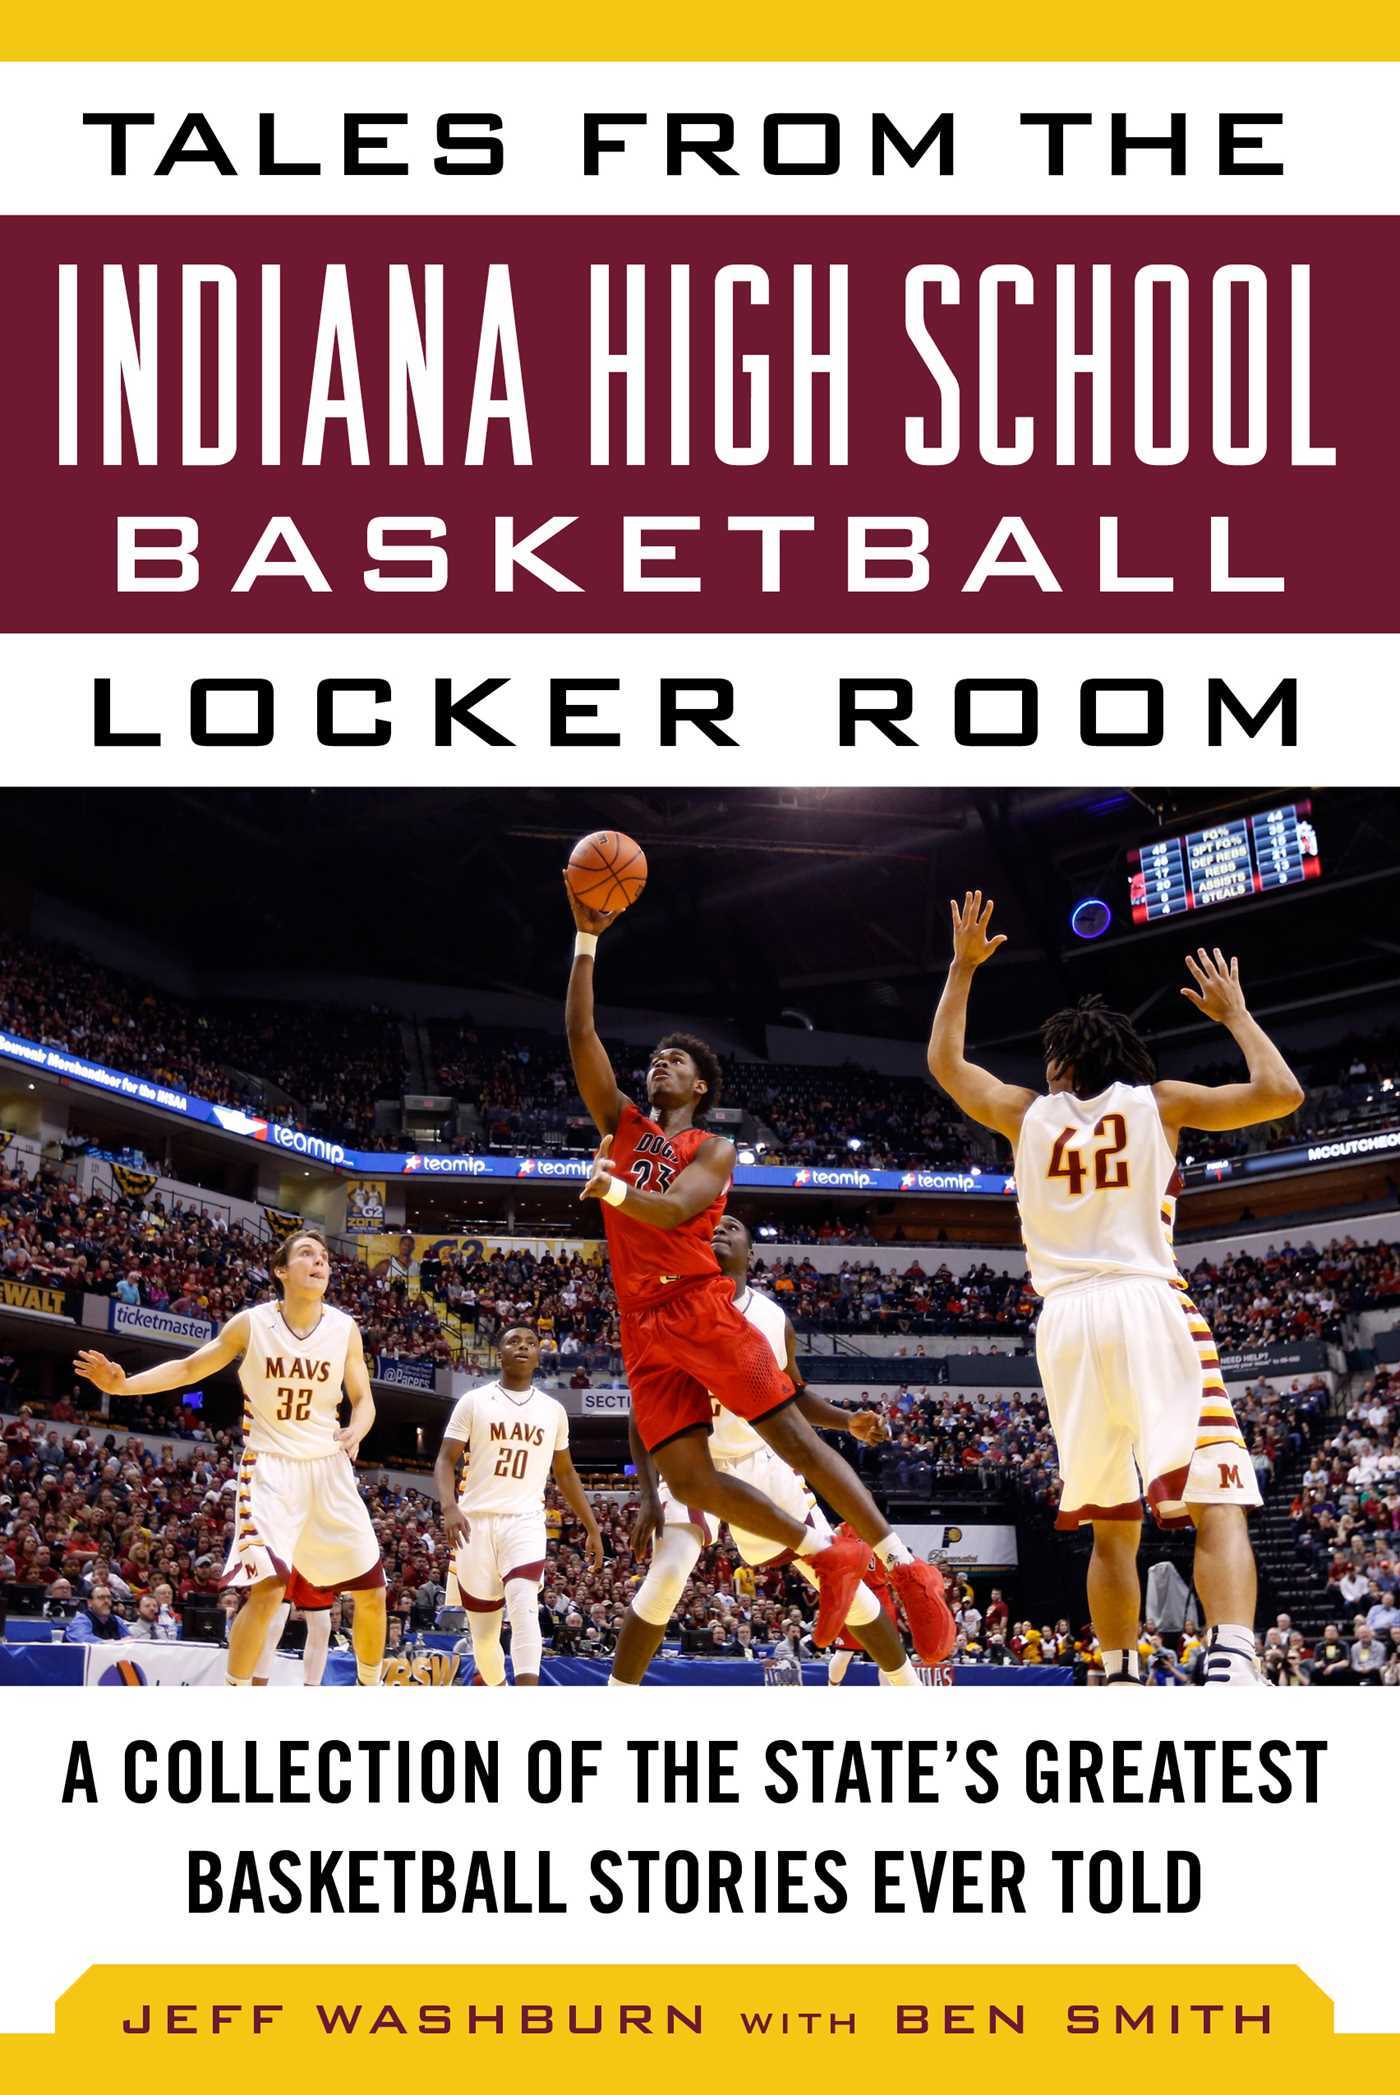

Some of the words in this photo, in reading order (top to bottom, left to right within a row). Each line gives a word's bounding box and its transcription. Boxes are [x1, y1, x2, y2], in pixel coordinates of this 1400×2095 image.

[1205, 861, 1236, 878] REBS
[1199, 871, 1246, 893] ASSISTS
[1202, 884, 1246, 904] STEALS
[121, 1077, 138, 1094] for
[1046, 1112, 1130, 1195] 42
[1308, 1131, 1400, 1161] MCCUTCHEO
[362, 1206, 384, 1218] G2
[117, 1307, 211, 1339] ticketmaster
[265, 1357, 331, 1382] MAVS
[384, 1367, 431, 1389] @Pacers
[276, 1387, 313, 1421] 32
[489, 1422, 545, 1446] MAVS
[494, 1447, 529, 1479] 20
[1217, 1463, 1244, 1489] M
